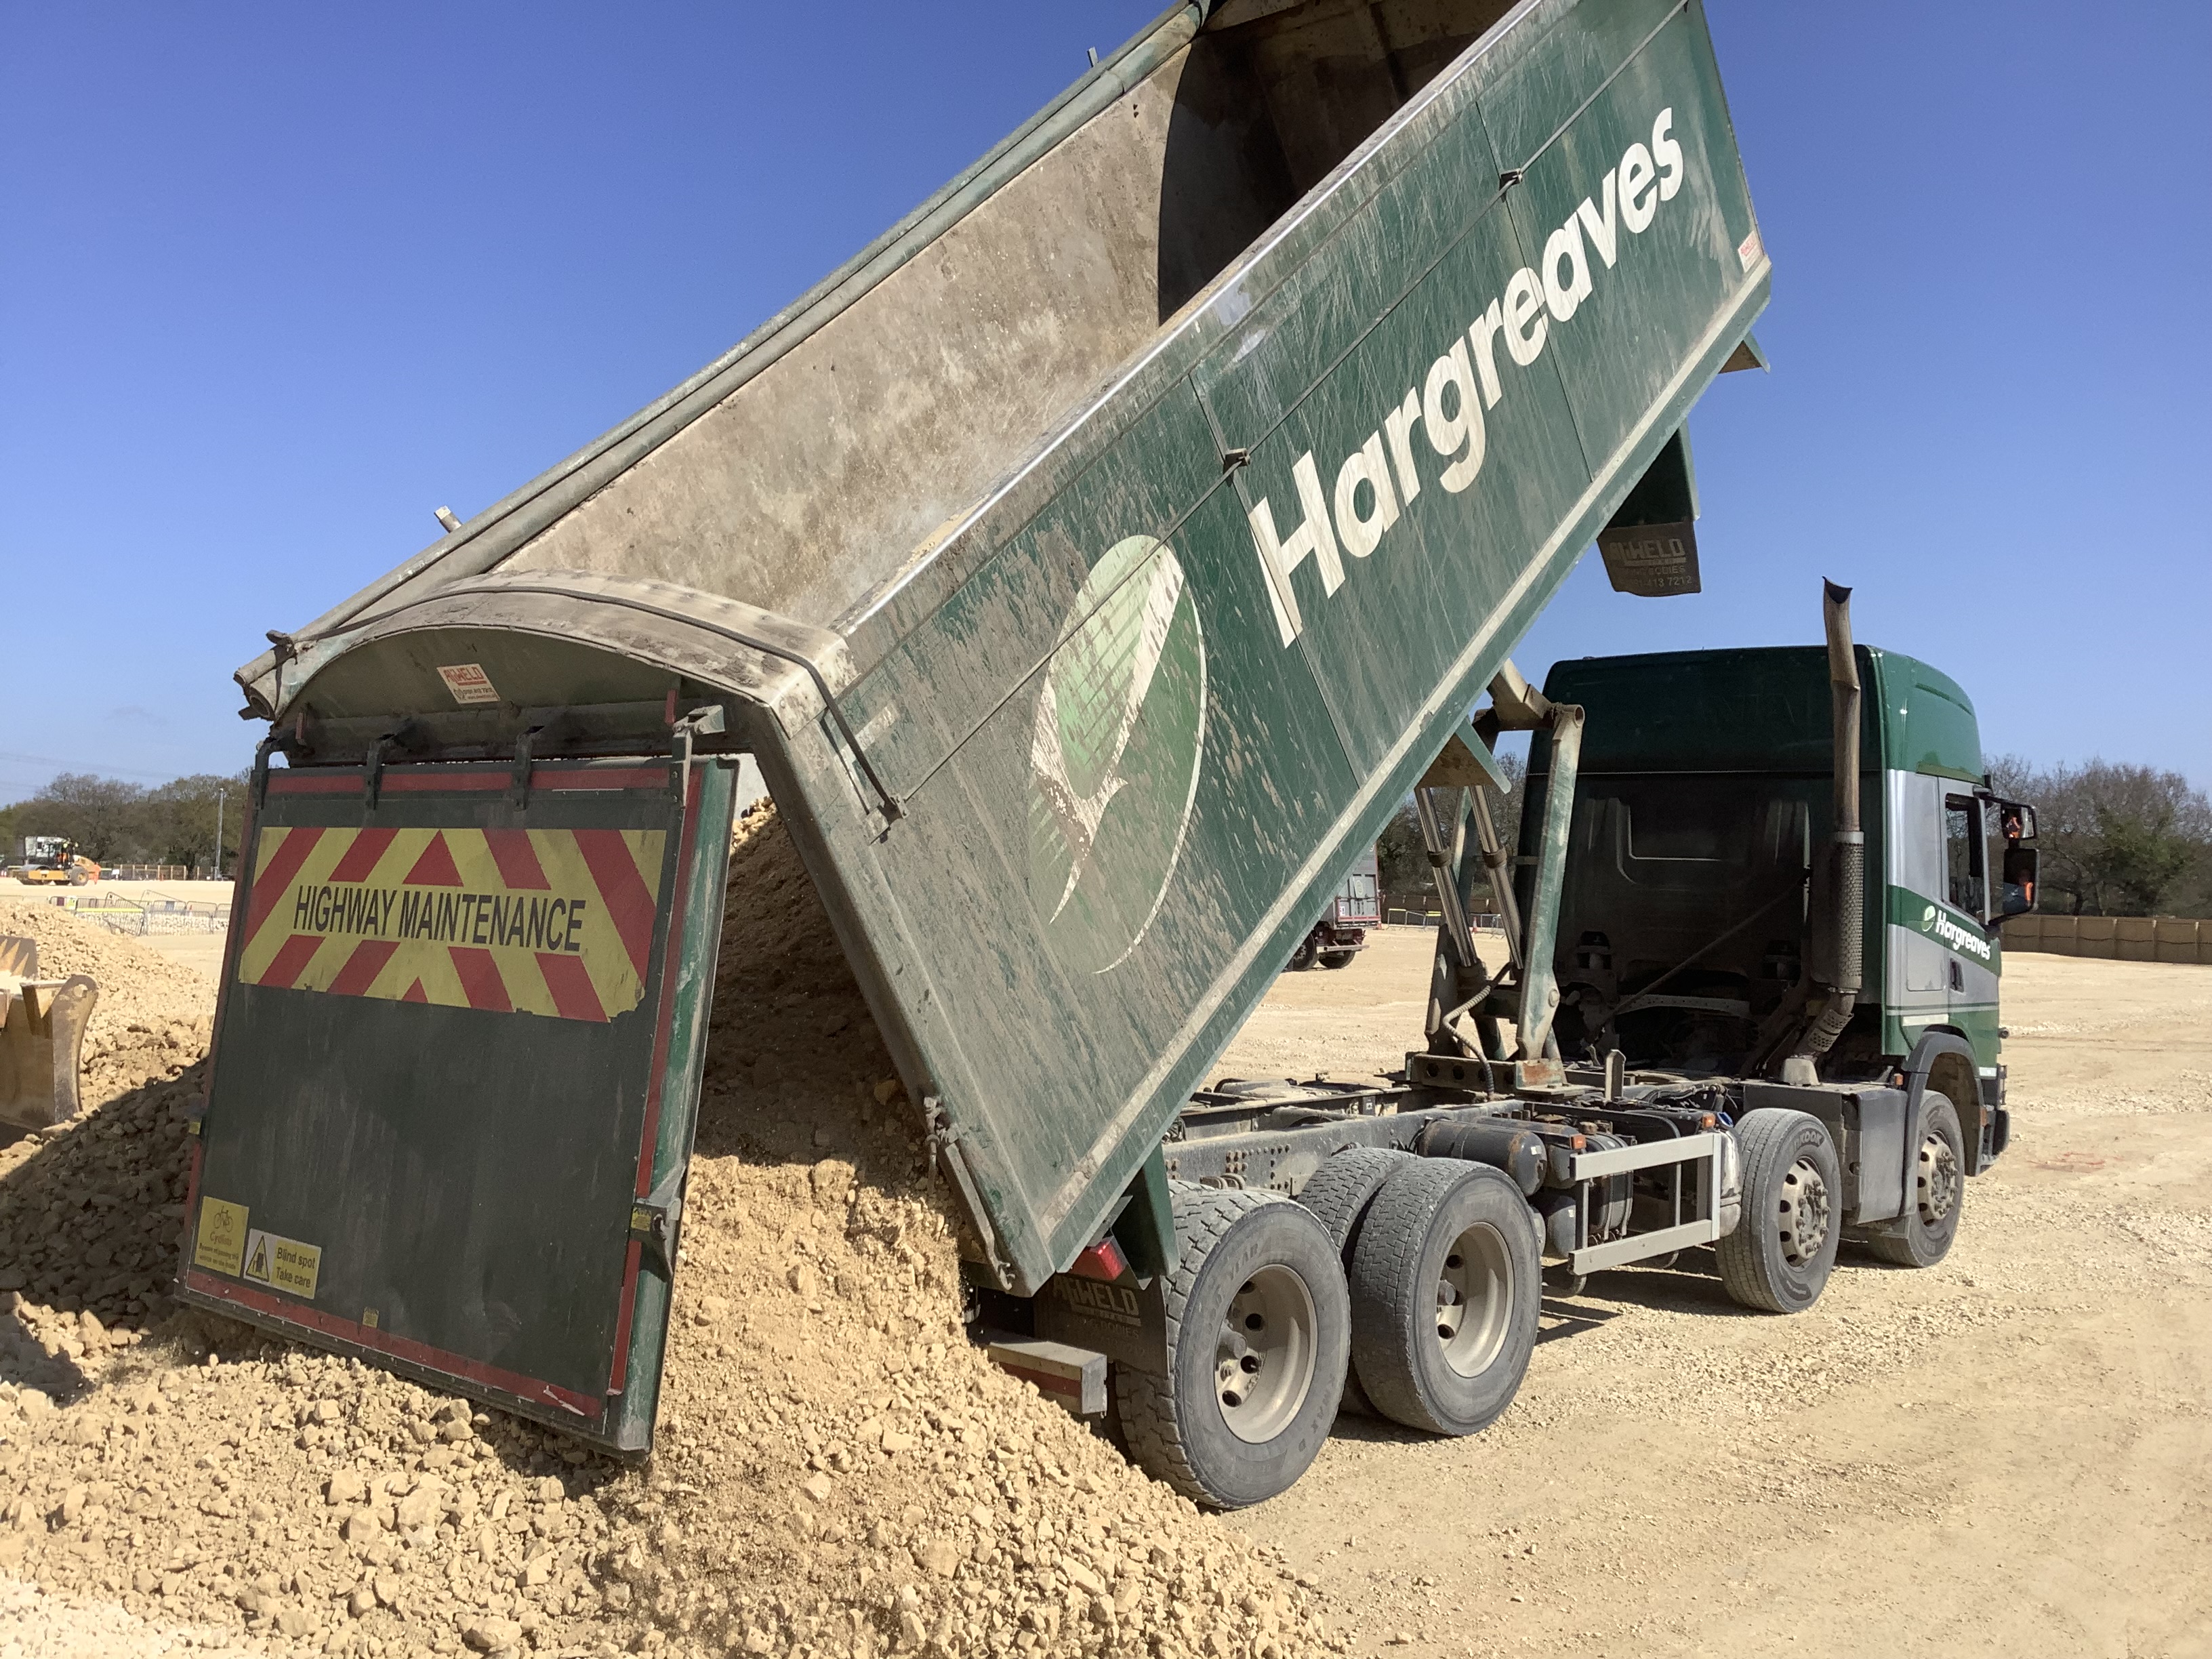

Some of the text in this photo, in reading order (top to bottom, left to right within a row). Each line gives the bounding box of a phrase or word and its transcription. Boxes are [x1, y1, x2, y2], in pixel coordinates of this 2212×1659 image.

[1249, 106, 1684, 649] Hargreaves
[1668, 575, 1692, 587] 7212
[293, 884, 586, 952] HIGHWAY MAINTENANCE
[1936, 909, 1991, 960] Hargreaves
[276, 1247, 316, 1269] Blind spot
[276, 1267, 311, 1288] Take care
